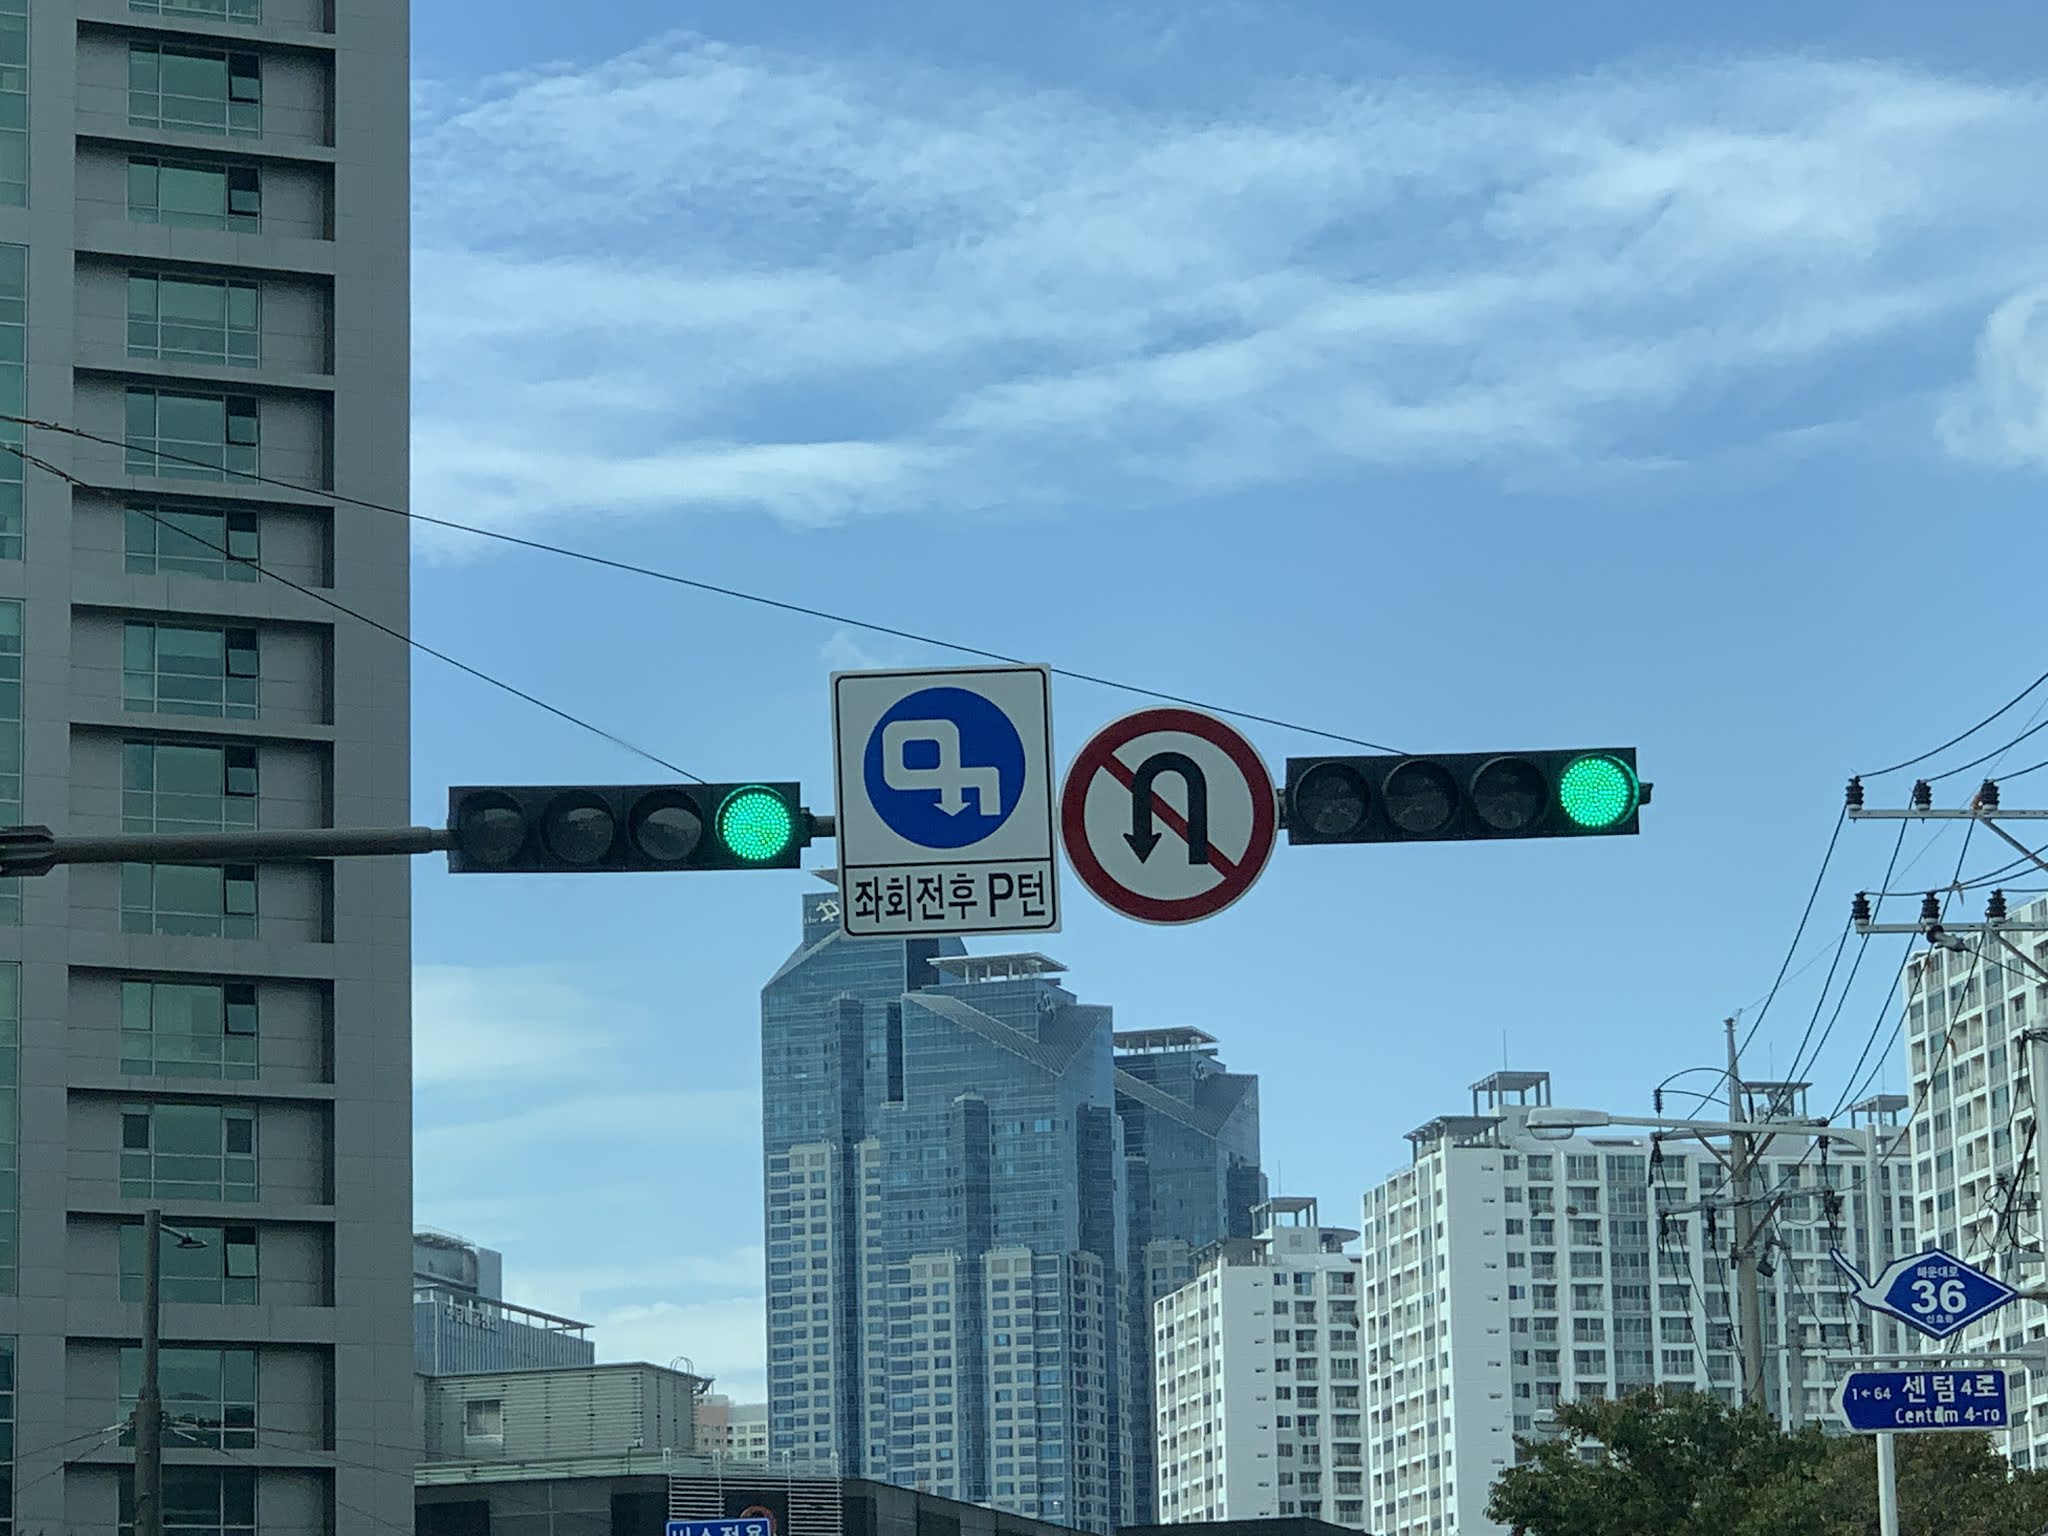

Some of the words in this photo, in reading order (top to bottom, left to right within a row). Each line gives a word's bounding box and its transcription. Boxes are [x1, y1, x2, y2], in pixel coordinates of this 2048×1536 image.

[855, 873, 978, 924] 좌회전후
[988, 870, 1046, 917] P턴
[1911, 1279, 1967, 1314] 36
[1873, 1386, 1892, 1400] 64
[1963, 1405, 2001, 1422] 4-ro
